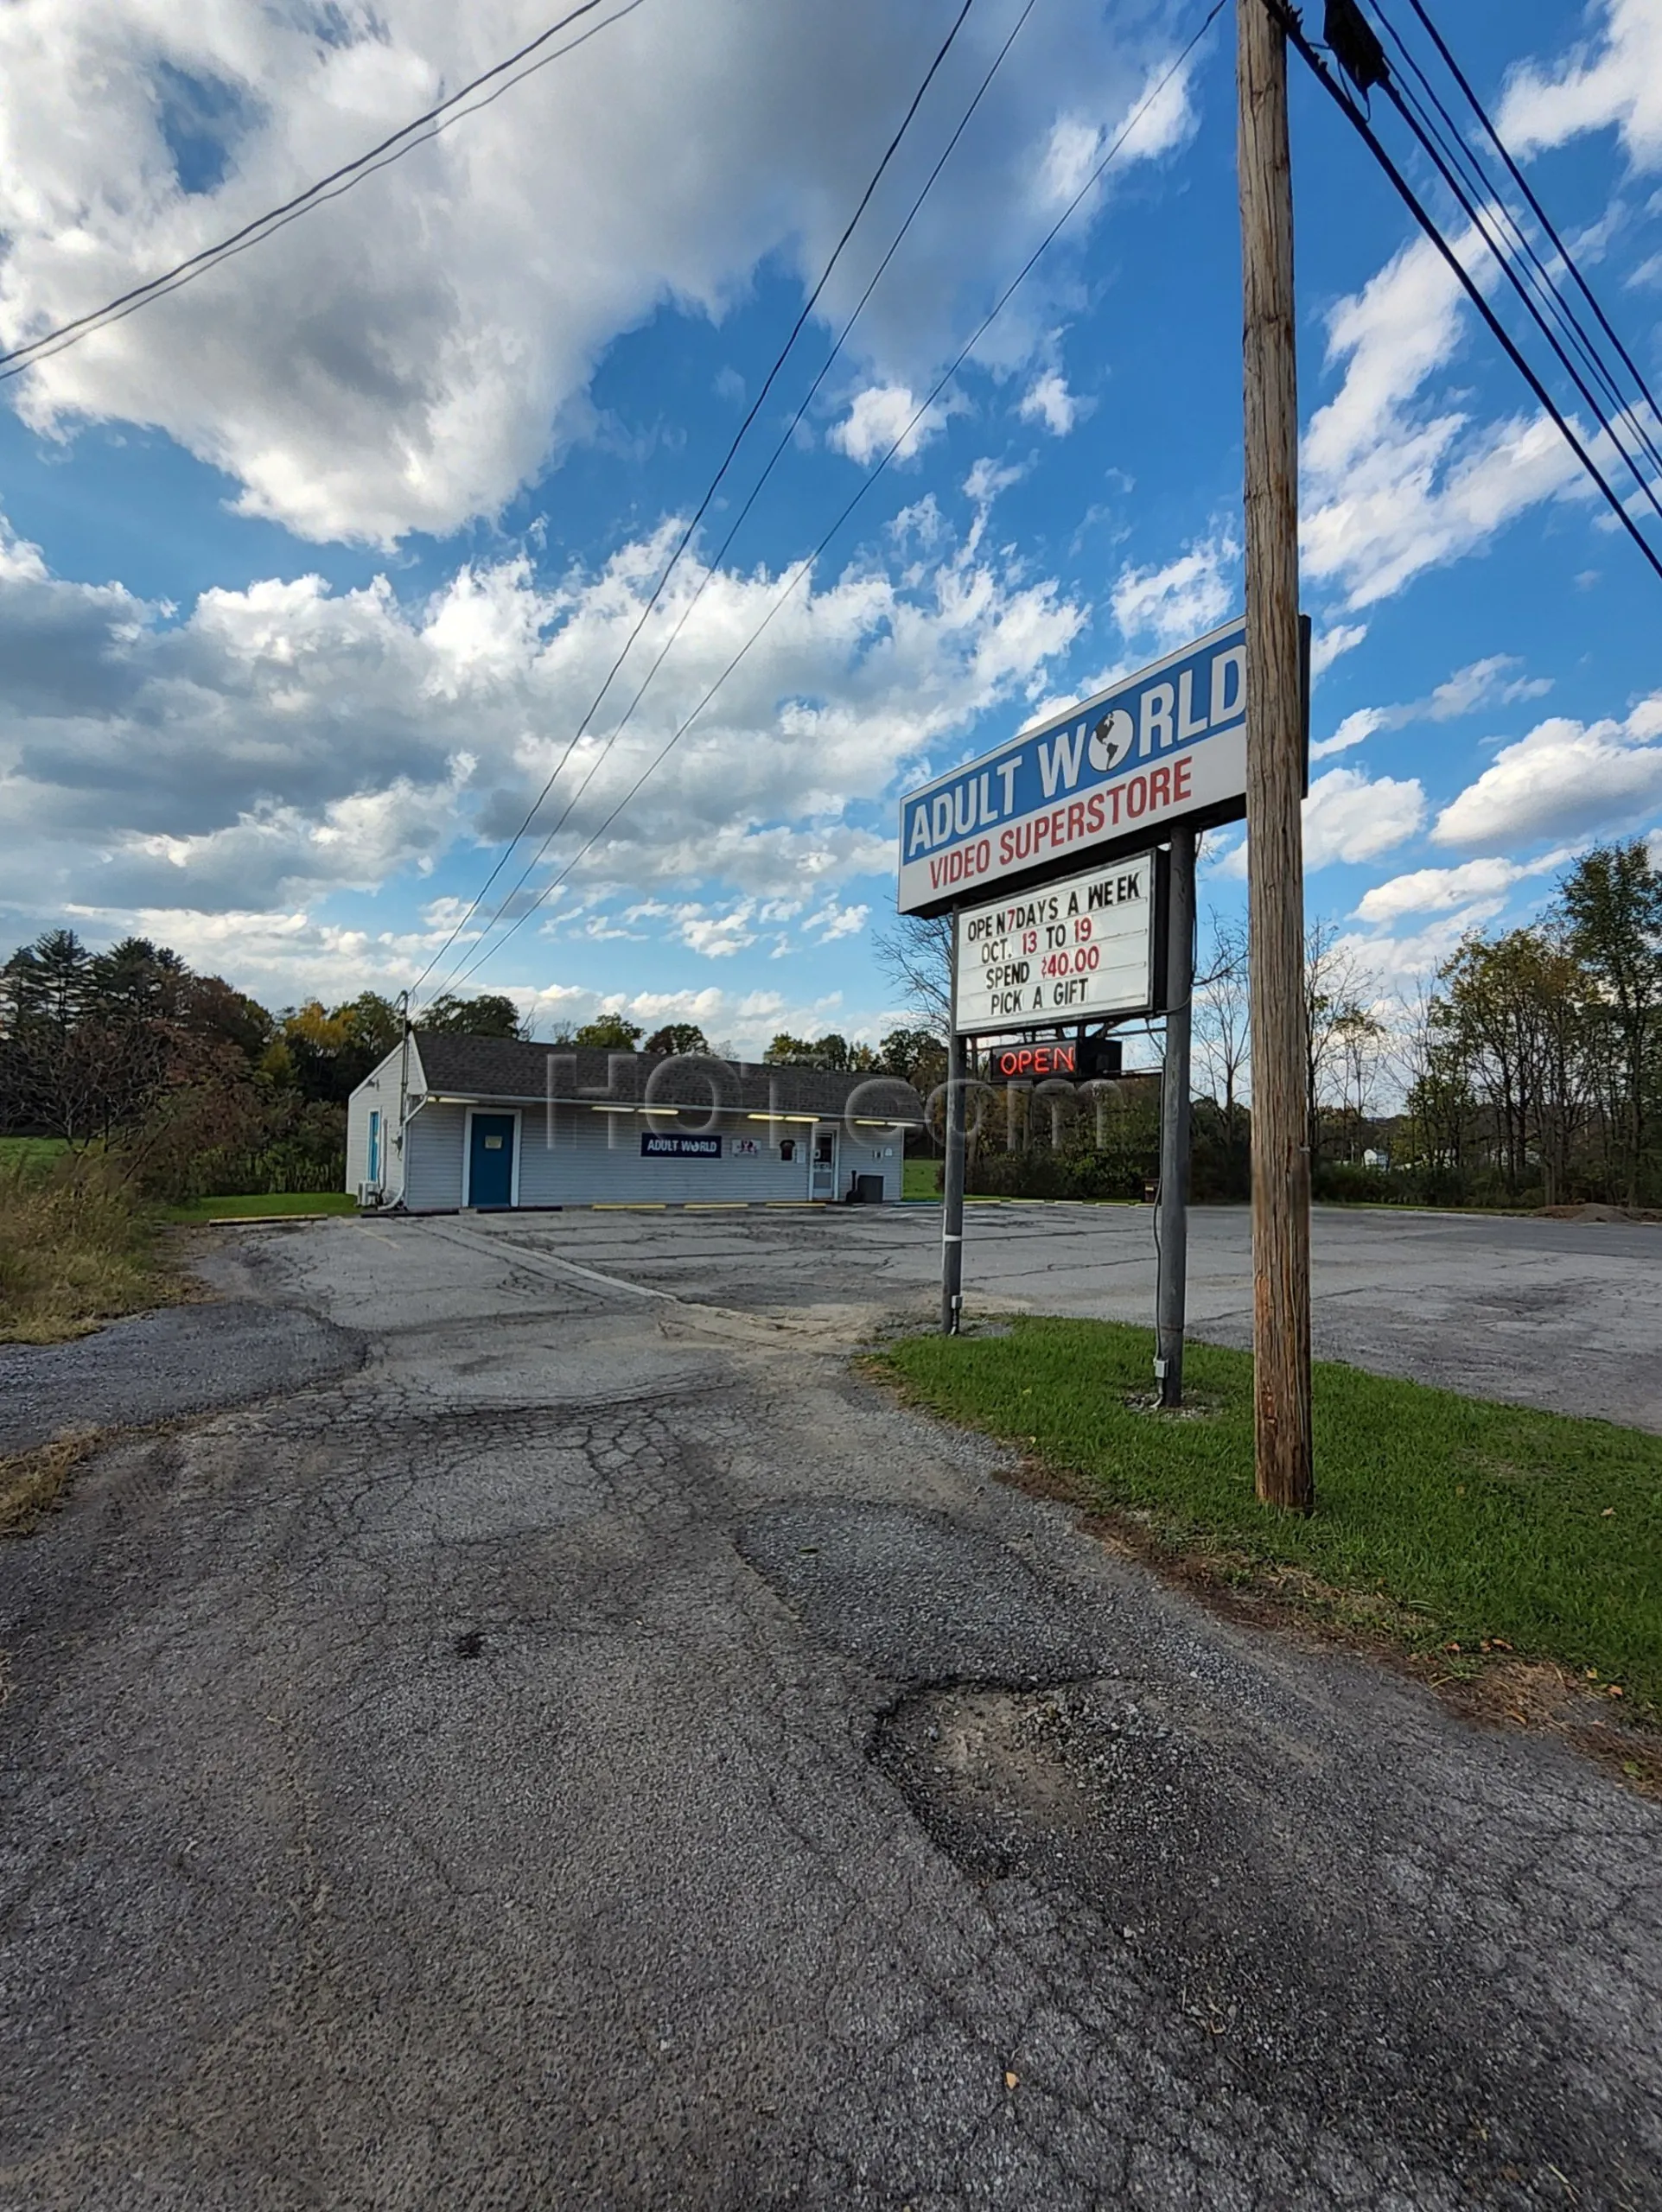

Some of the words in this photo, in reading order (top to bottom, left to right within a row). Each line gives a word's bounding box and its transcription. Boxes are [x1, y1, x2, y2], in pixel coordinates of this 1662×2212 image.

[908, 756, 1022, 857] ADULT
[1038, 645, 1248, 798] WORLD
[930, 839, 990, 890] VIDEO
[999, 756, 1193, 866] SUPERSTORE
[1067, 892, 1079, 916] A
[1088, 873, 1140, 909] WEEK
[982, 938, 1012, 964] OCT.
[1022, 931, 1037, 956] 13
[1046, 925, 1067, 950] TO
[1074, 917, 1092, 943] 19
[986, 961, 1029, 990] SPEND
[1041, 945, 1100, 979] $40.00
[990, 989, 1022, 1015] PICK
[1033, 986, 1042, 1010] A
[1054, 977, 1089, 1006] GIFT
[1000, 1046, 1075, 1075] OPEN
[647, 1139, 678, 1152] ADULT
[681, 1140, 717, 1153] WORLD
